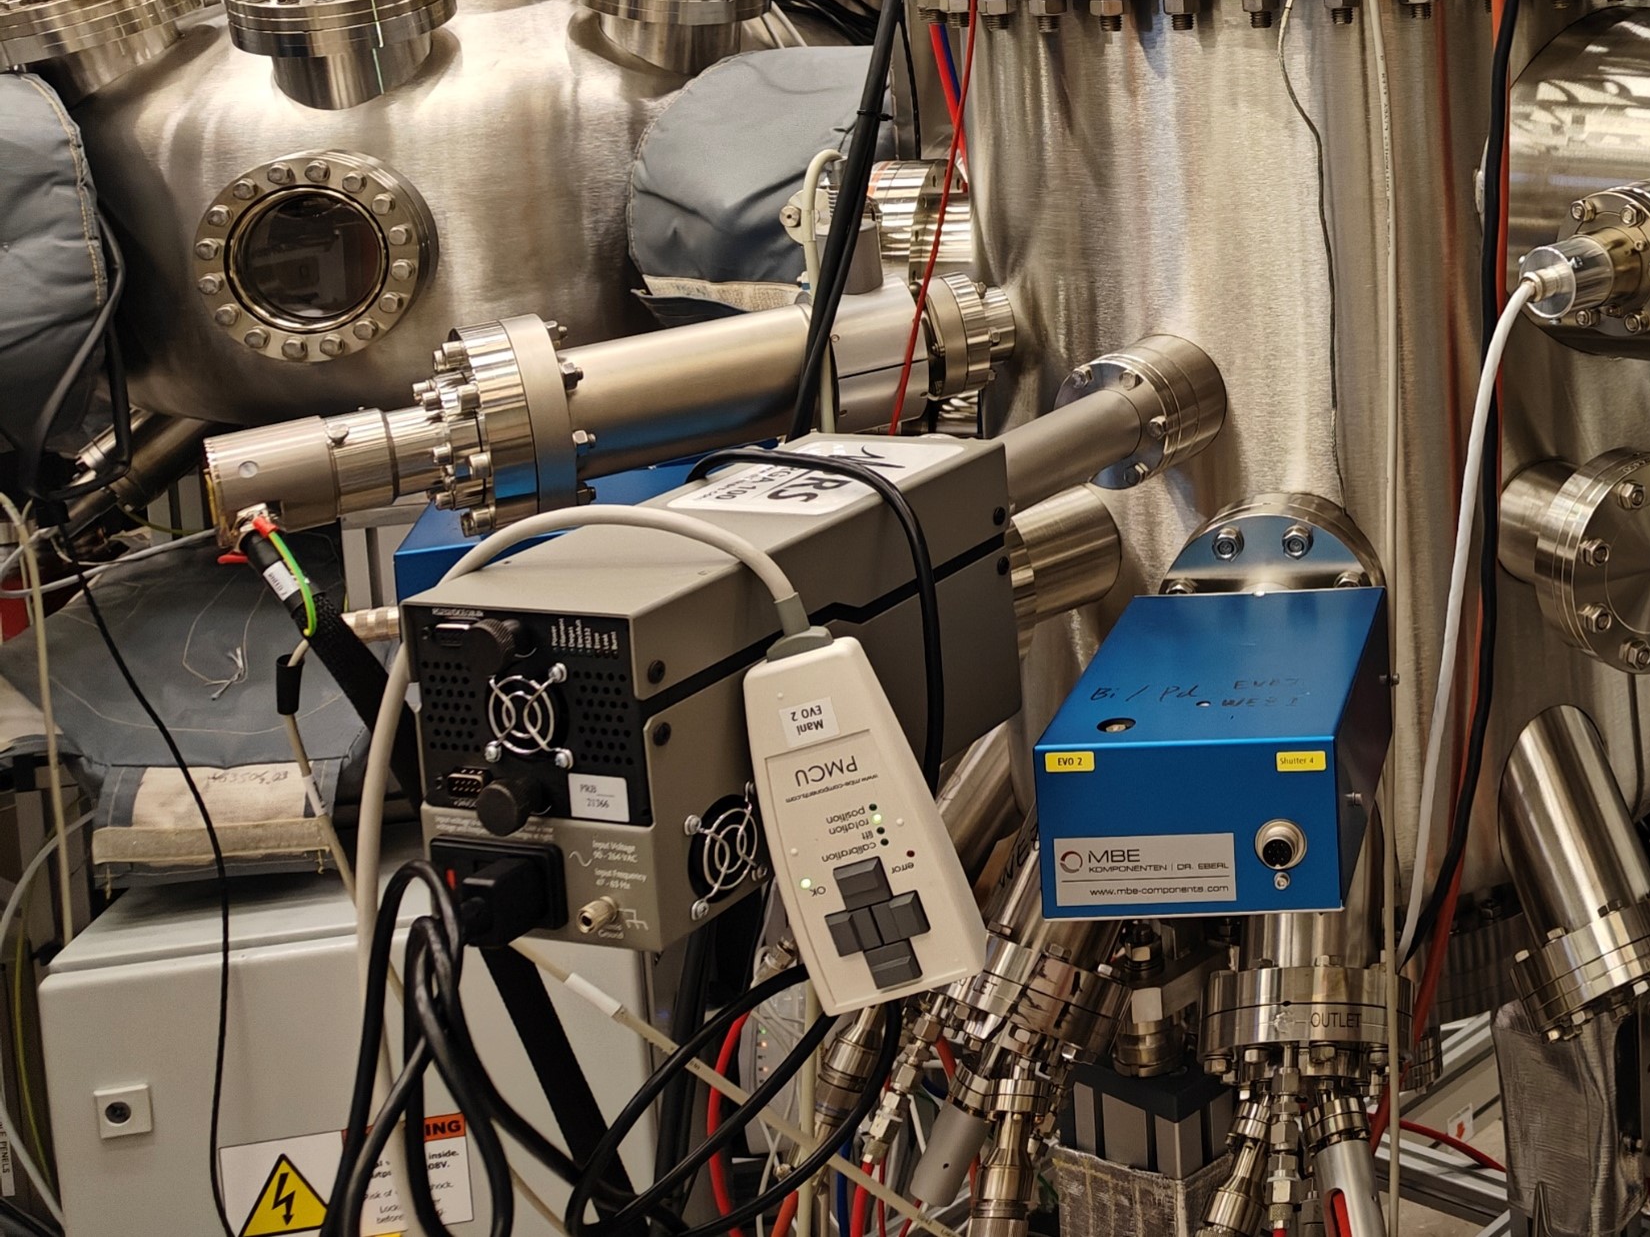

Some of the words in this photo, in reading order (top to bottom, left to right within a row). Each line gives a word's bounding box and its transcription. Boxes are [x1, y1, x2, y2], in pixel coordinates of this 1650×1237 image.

[790, 711, 799, 722] 2
[801, 704, 823, 719] EVO
[1057, 757, 1075, 766] EVO
[1077, 757, 1083, 766] 2
[1279, 756, 1307, 765] Shutter
[1309, 756, 1314, 764] 4
[794, 755, 858, 787] PMCU
[825, 805, 866, 825] position
[828, 818, 870, 835] rotation
[861, 830, 874, 840] lift
[821, 842, 877, 863] calibration
[1088, 848, 1141, 864] MBE
[891, 862, 915, 874] error
[1088, 864, 1168, 874] KOMPONENTEN
[1176, 863, 1194, 871] DR.
[1197, 862, 1229, 871] EBERL
[809, 883, 827, 897] OK
[1089, 885, 1229, 897] www.mbe-components.com
[1310, 1012, 1362, 1028] OUTLET
[428, 1149, 460, 1160] inside.
